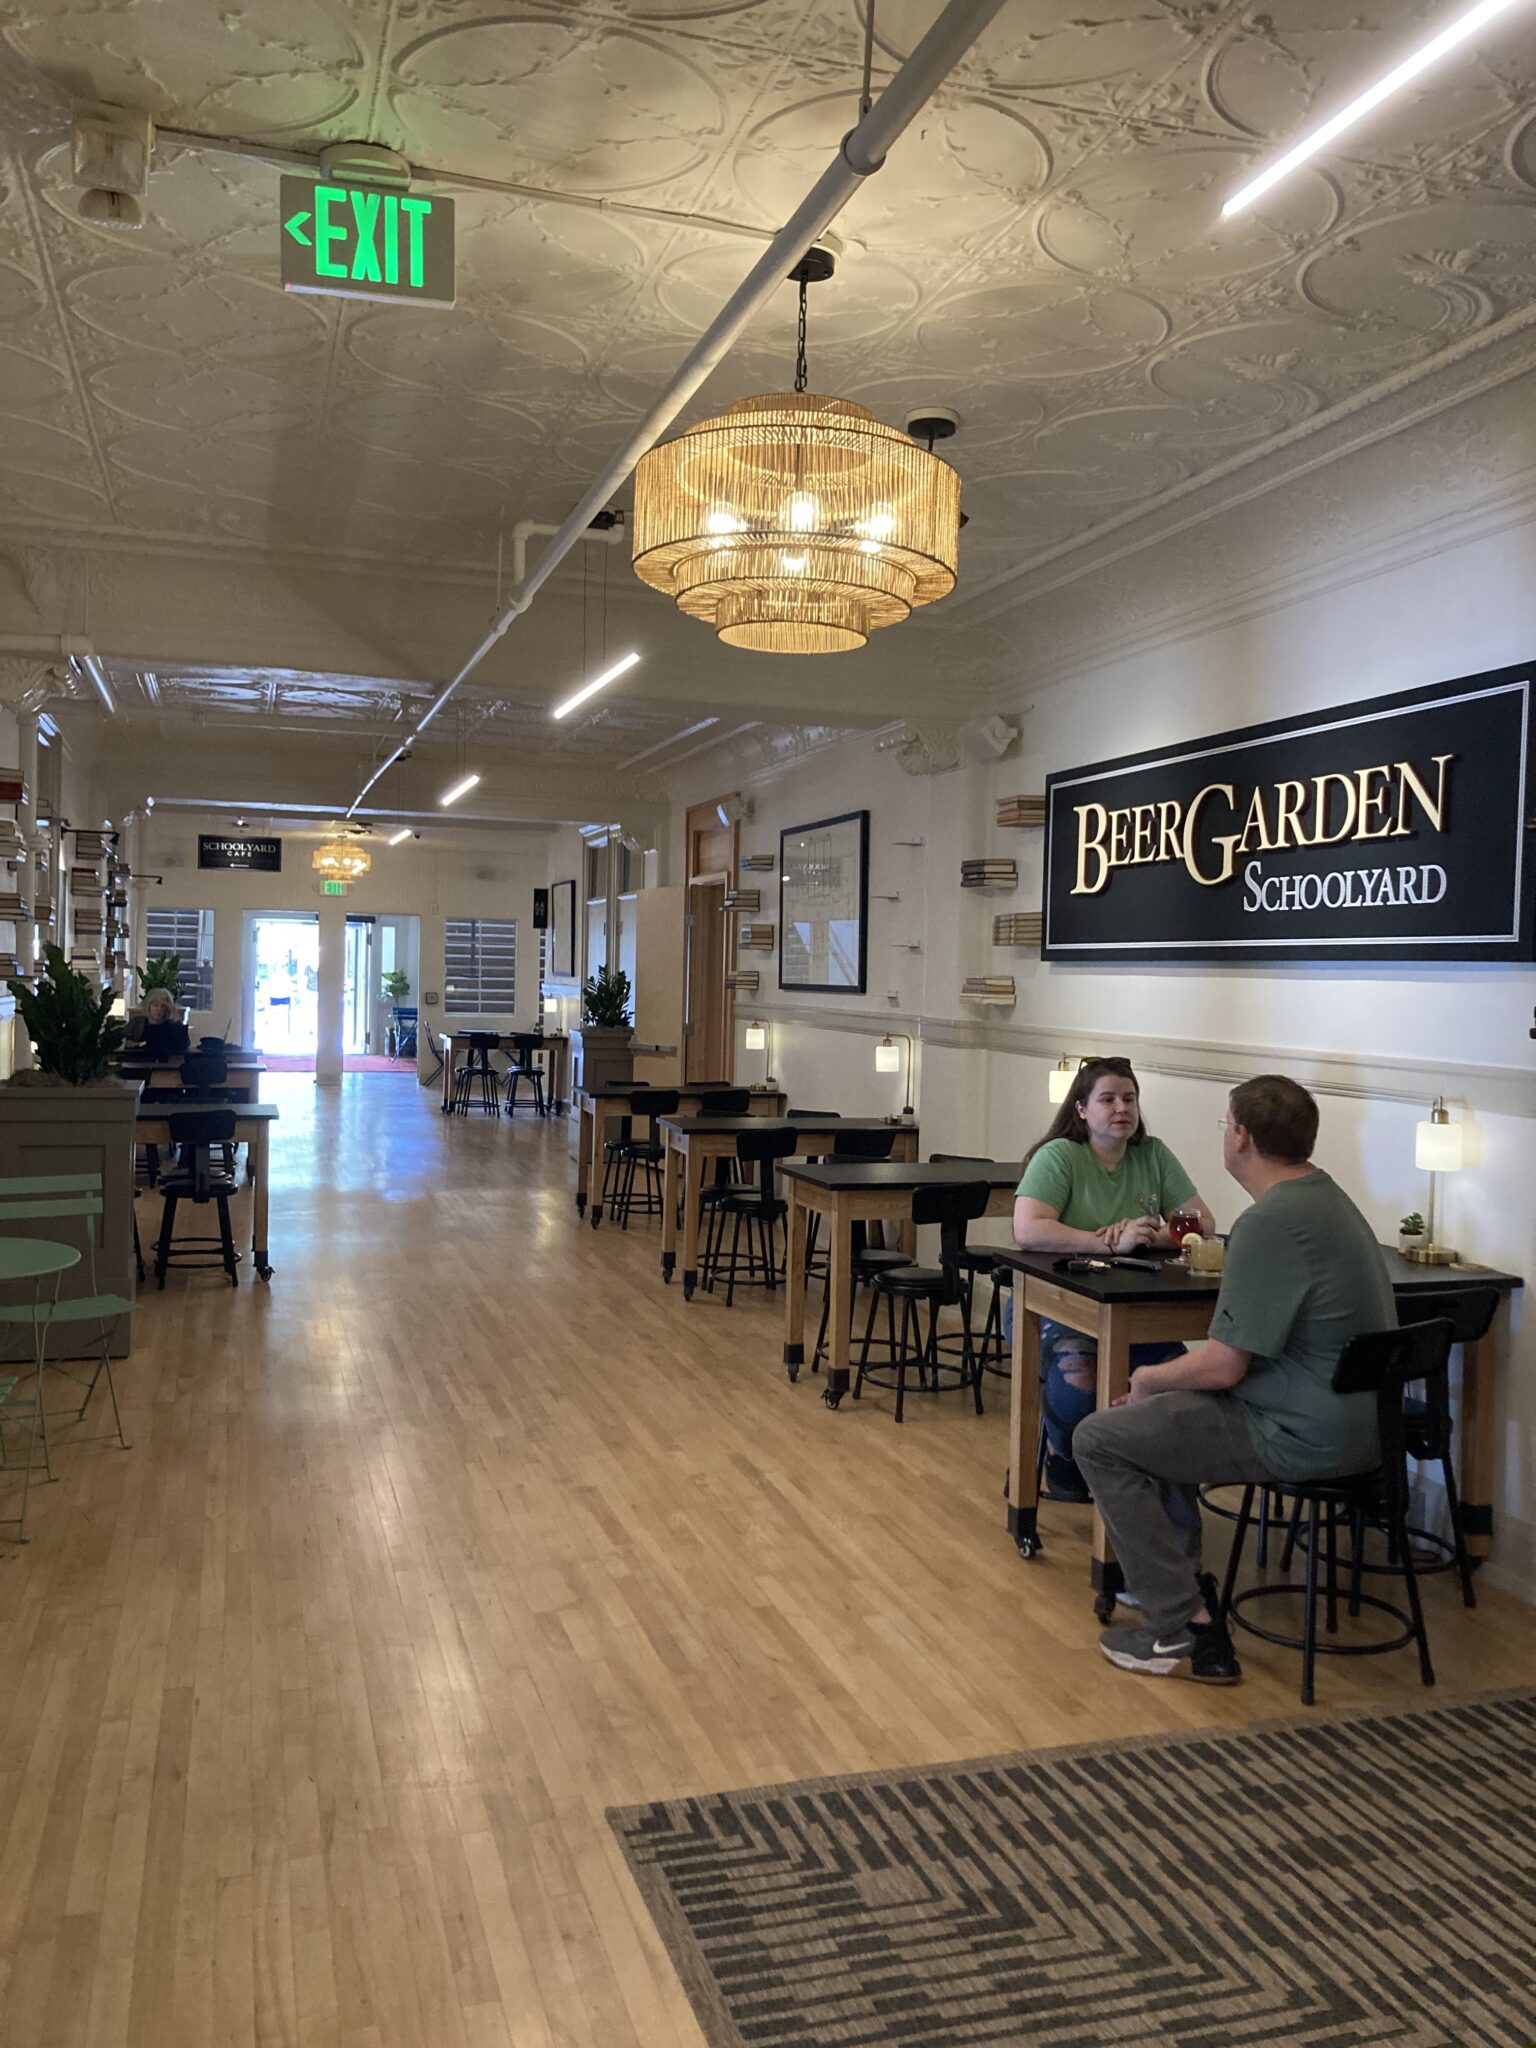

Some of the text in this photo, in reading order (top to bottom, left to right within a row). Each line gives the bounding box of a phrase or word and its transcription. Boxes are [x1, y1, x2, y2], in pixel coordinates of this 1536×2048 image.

[315, 186, 431, 287] EXIT
[203, 842, 276, 854] SCHOOLYARD
[324, 880, 343, 895] EXIT
[1242, 860, 1448, 912] SCHOOLYARD
